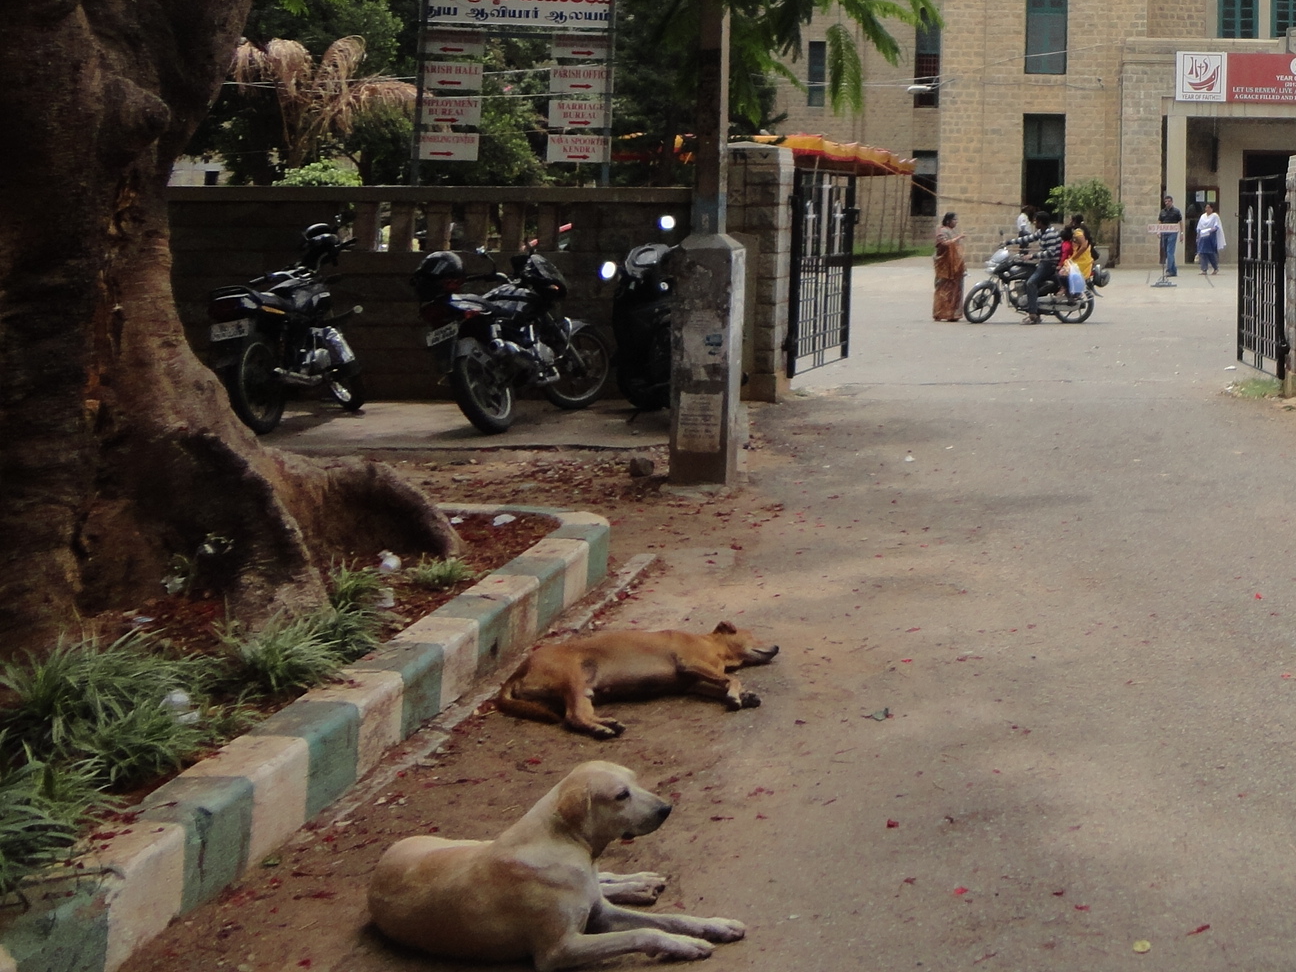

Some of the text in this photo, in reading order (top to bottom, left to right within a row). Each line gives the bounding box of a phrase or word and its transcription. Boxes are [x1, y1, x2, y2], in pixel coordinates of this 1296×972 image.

[466, 6, 540, 21] ஆவியார்
[545, 9, 612, 24] ஆலயம்
[455, 66, 480, 75] HALL
[553, 69, 581, 79] PARISH
[557, 103, 605, 111] MARRIAGE
[428, 108, 463, 116] BUREAU
